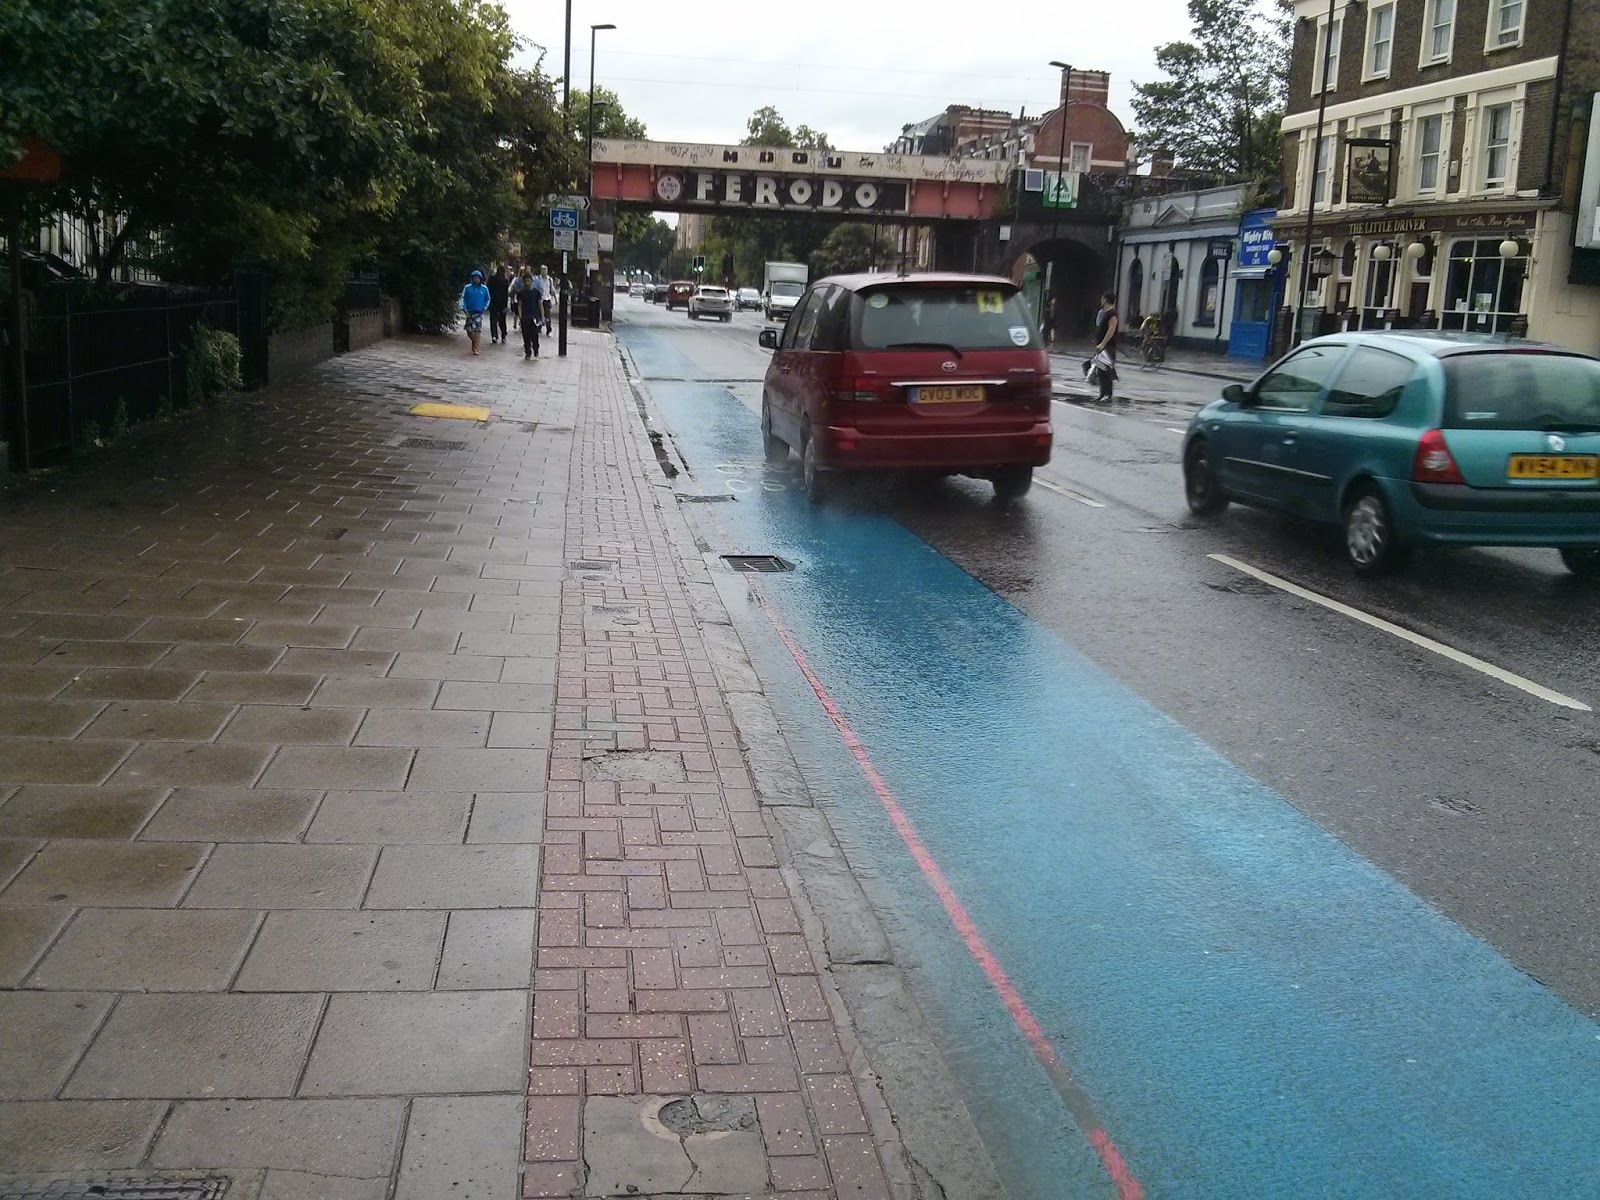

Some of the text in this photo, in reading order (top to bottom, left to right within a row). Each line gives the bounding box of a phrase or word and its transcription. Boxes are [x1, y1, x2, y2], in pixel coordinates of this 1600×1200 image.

[696, 173, 878, 209] FERODO
[1349, 218, 1426, 234] THE LITTLE DRIVER
[919, 388, 952, 401] GV03
